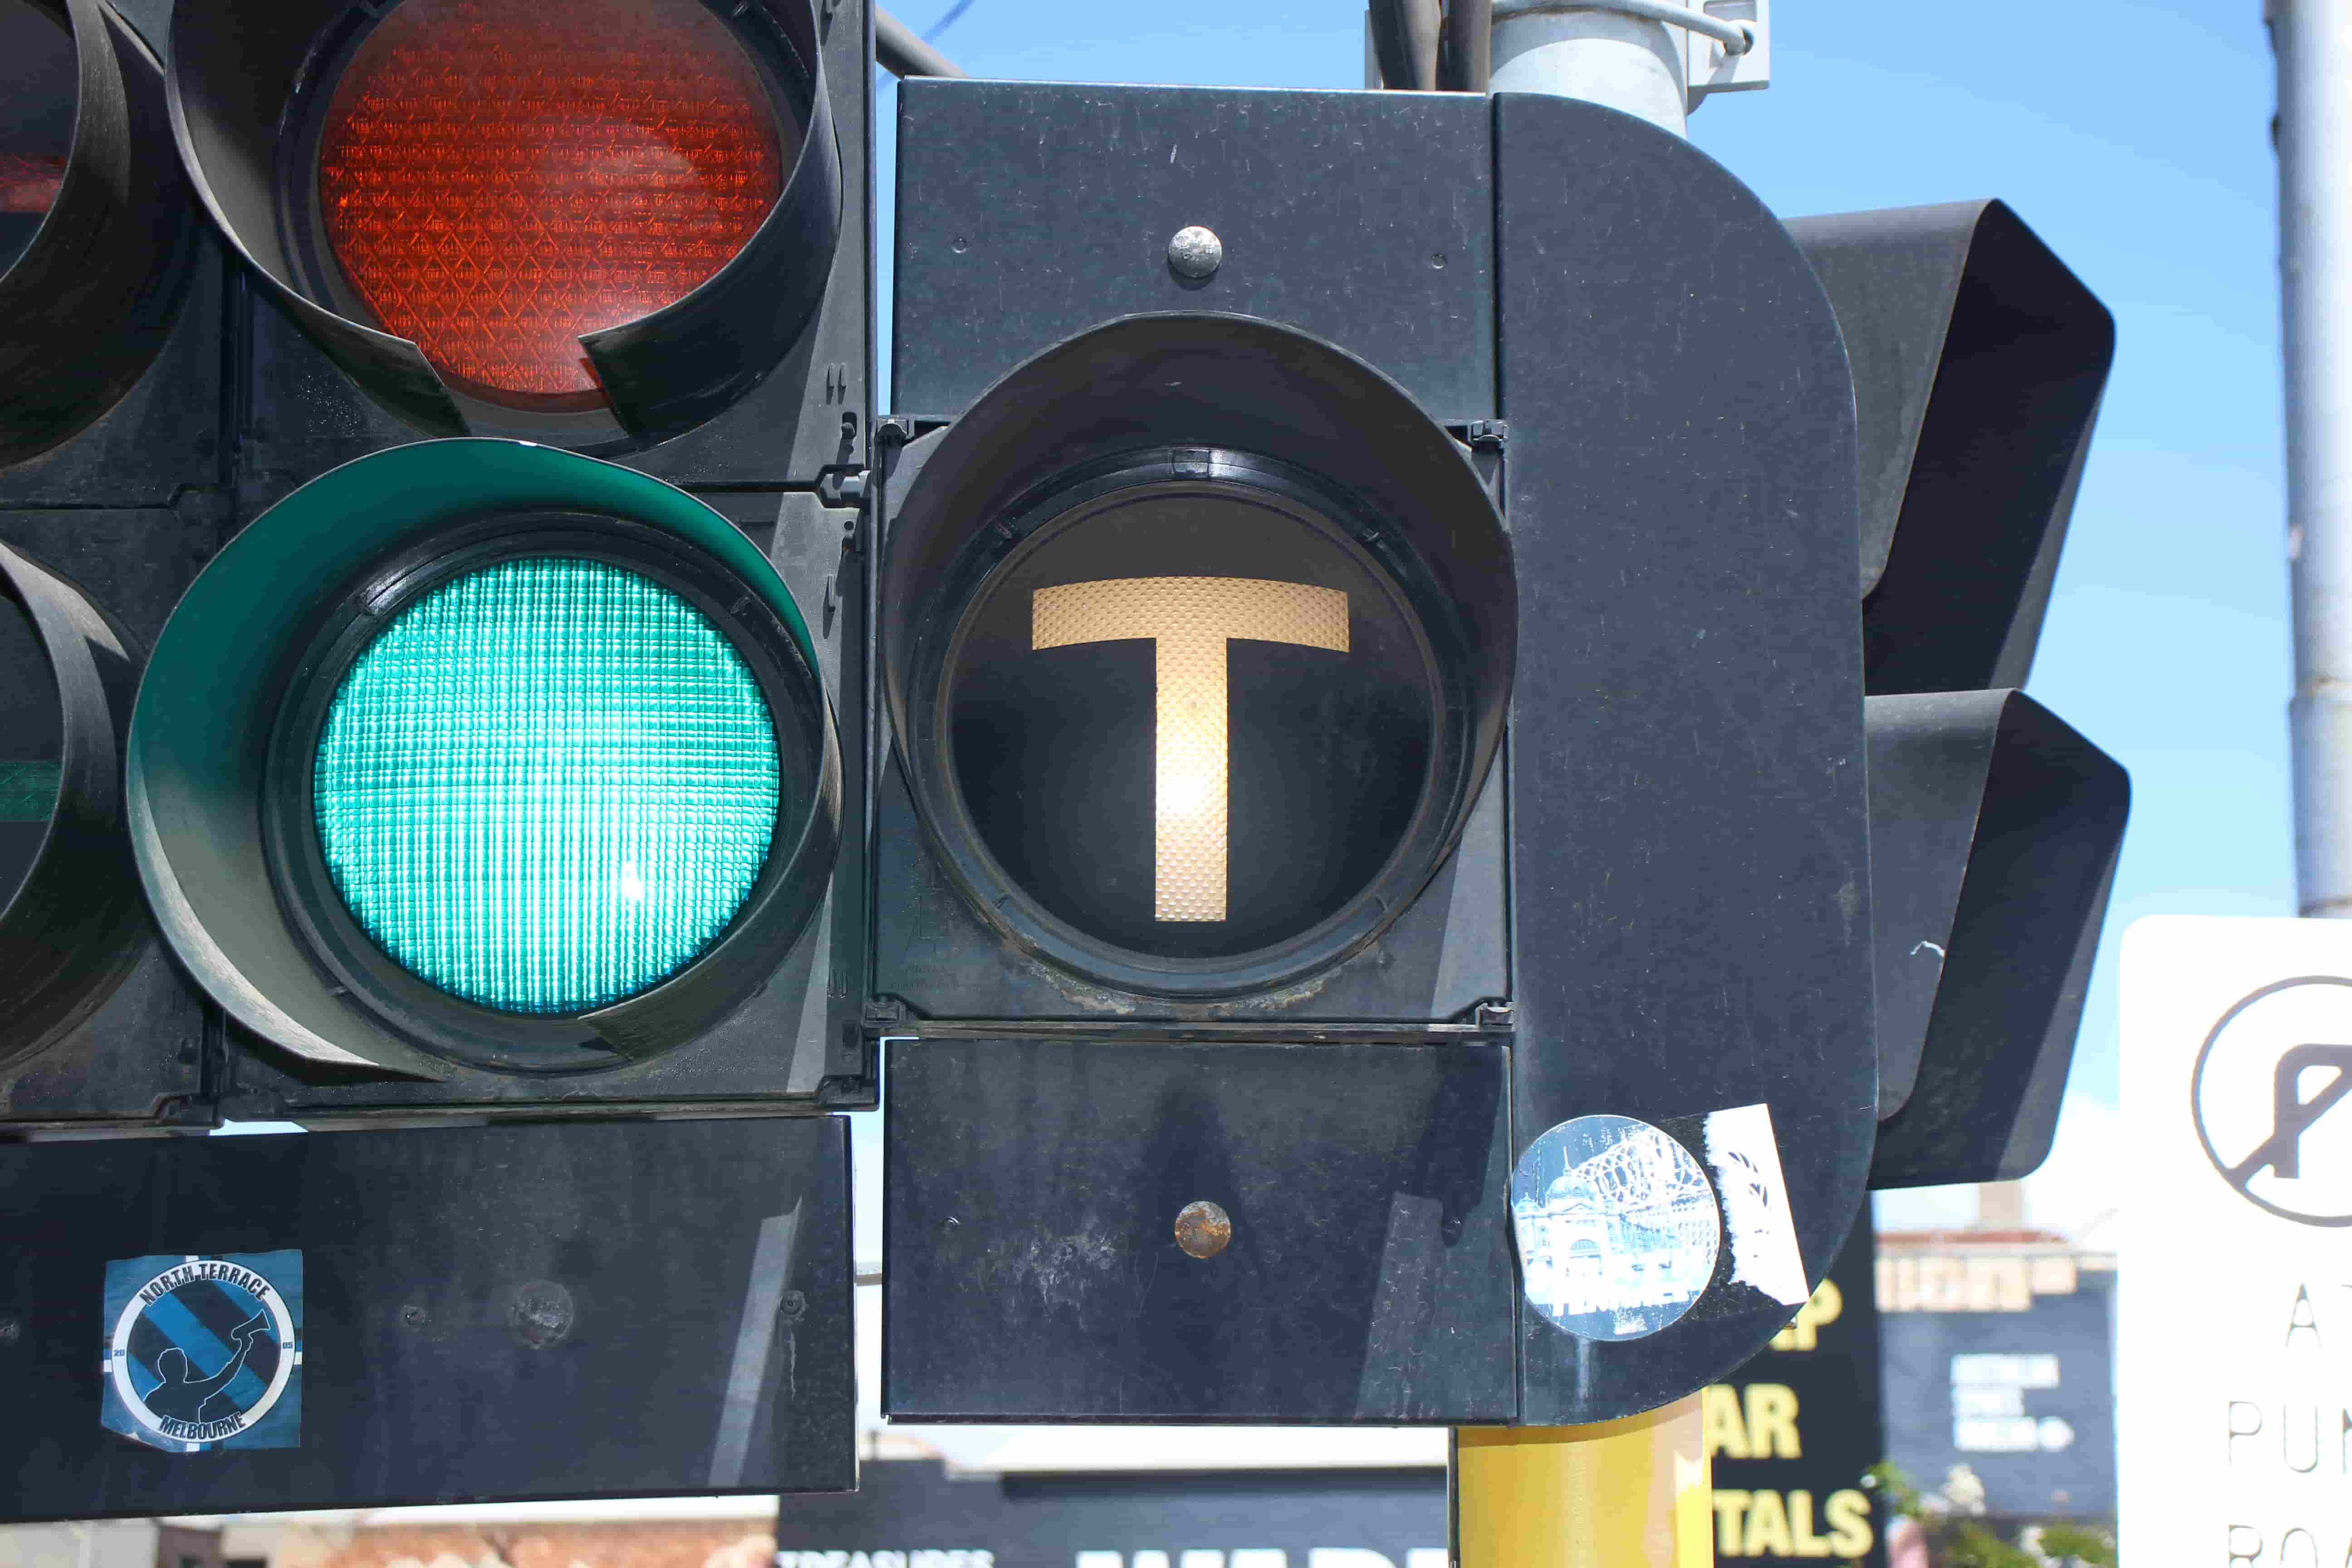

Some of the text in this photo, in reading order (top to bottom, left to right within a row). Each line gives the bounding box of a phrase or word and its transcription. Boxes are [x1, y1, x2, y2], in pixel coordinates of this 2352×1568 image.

[1032, 577, 1350, 921] T
[139, 1264, 271, 1306] NORTH TERRACE
[160, 1413, 246, 1438] MELBOURNE
